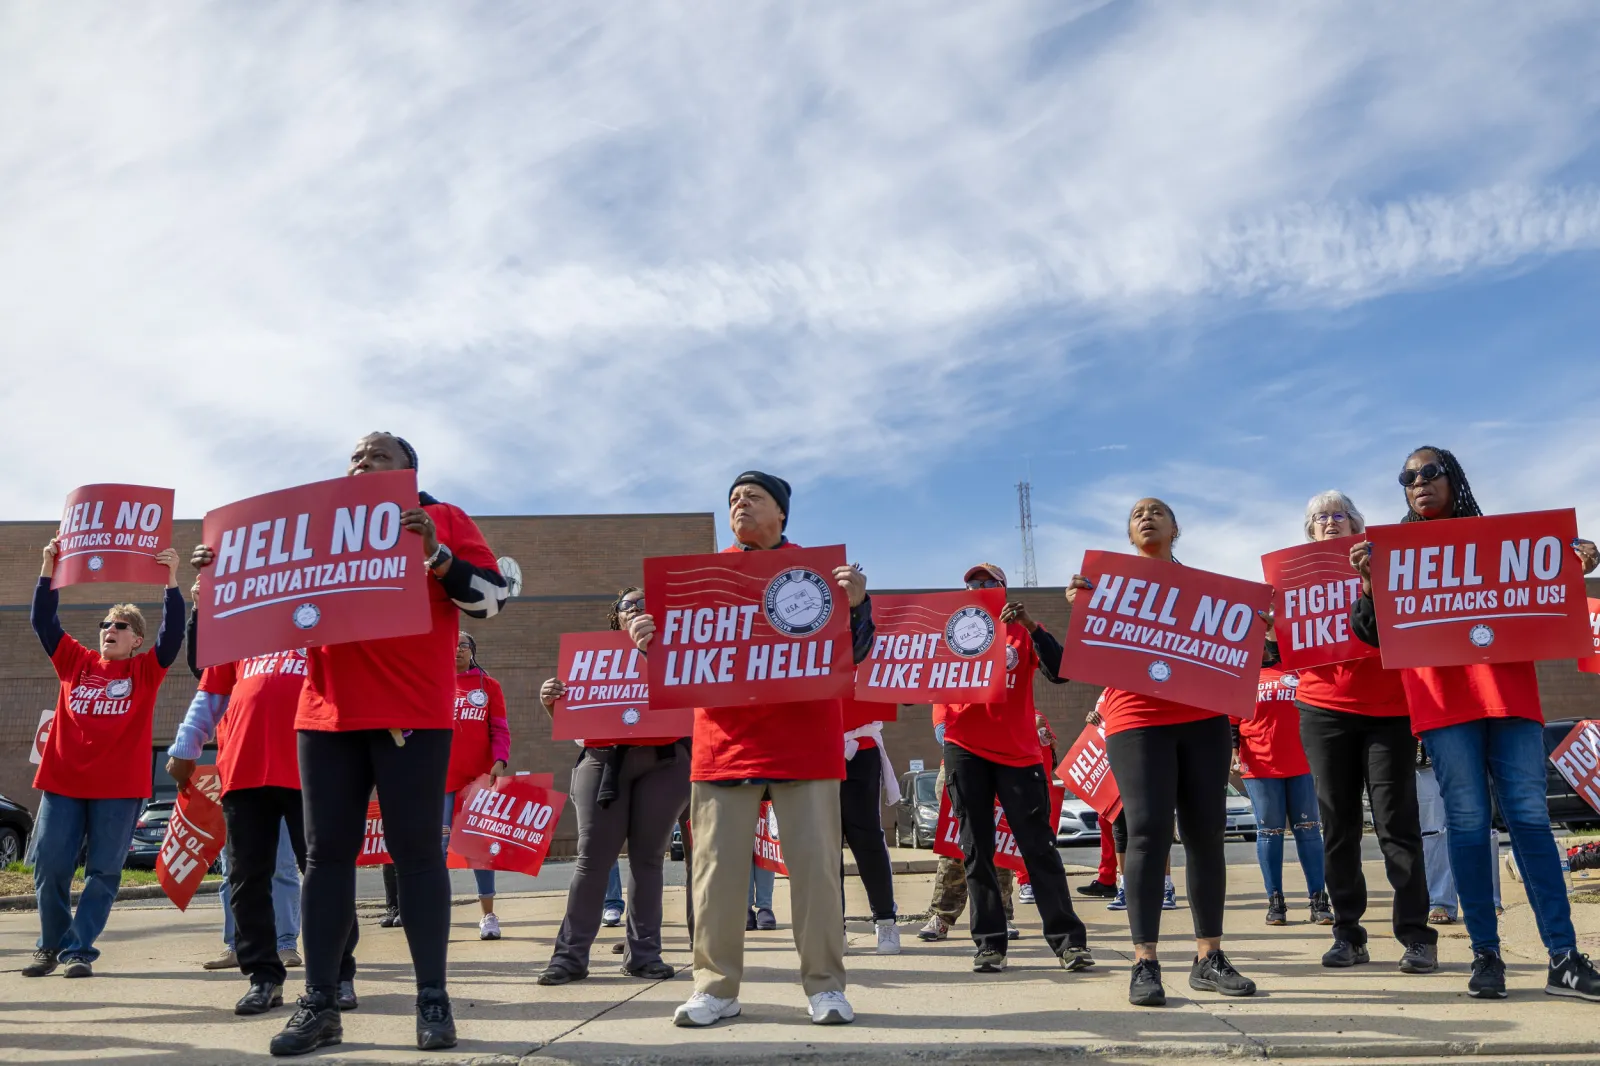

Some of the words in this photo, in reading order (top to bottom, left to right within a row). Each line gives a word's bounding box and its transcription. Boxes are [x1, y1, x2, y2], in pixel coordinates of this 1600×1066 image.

[60, 501, 104, 537] HELL
[114, 501, 162, 532] NO
[60, 537, 69, 551] TO
[68, 533, 111, 549] ATTACKS
[114, 533, 136, 545] ON
[137, 535, 159, 549] US!
[214, 513, 313, 578] HELL
[330, 502, 402, 555] NO
[1388, 543, 1483, 591] HELL
[1498, 535, 1561, 583] NO
[214, 581, 237, 606] TO
[241, 556, 407, 600] PRIVATIZATION!
[1284, 577, 1361, 619] FIGHT
[1087, 573, 1180, 626] HELL
[1189, 594, 1253, 643] NO
[1394, 595, 1416, 615] TO
[1420, 589, 1498, 613] ATTACKS
[1503, 587, 1530, 608] ON
[1536, 584, 1566, 605] US!
[663, 604, 759, 645] FIGHT
[1083, 614, 1107, 635] TO
[1108, 620, 1249, 669] PRIVATIZATION!
[1291, 612, 1349, 651] LIKE
[664, 647, 737, 686] LIKE
[746, 639, 833, 681] HELL!
[871, 633, 942, 660] FIGHT
[243, 658, 279, 680] LIKE
[568, 648, 640, 682] HELL
[867, 663, 924, 689] LIKE
[927, 660, 993, 689] HELL!
[92, 700, 132, 715] HELL!
[567, 685, 585, 701] TO
[460, 707, 487, 721] HELL!
[1068, 740, 1104, 787] HELL
[1081, 780, 1093, 794] TO
[469, 788, 517, 821] HELL
[516, 800, 553, 830] NO
[185, 836, 205, 855] TO
[466, 814, 477, 826] TO
[476, 818, 513, 836] ATTACKS
[512, 827, 528, 840] ON
[527, 832, 544, 845] US!
